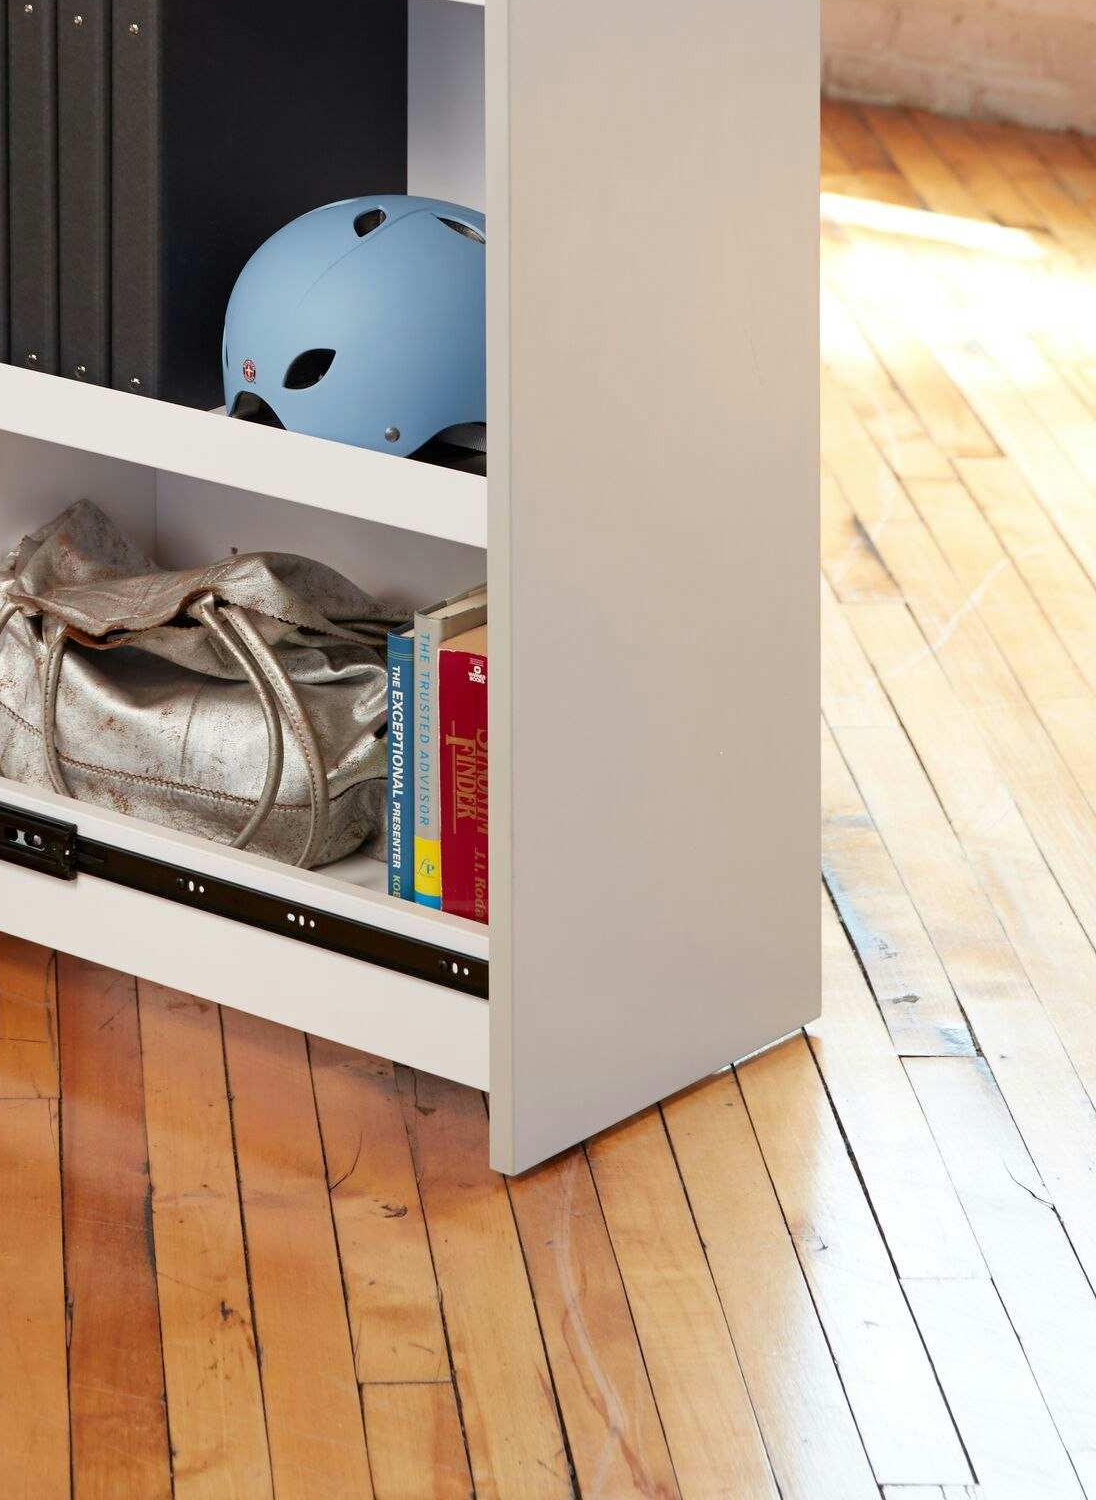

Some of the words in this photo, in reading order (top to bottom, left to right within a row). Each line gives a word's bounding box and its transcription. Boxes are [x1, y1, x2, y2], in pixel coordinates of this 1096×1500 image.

[392, 666, 401, 688] THE
[419, 632, 430, 662] THE
[419, 672, 430, 744] TRUSTED
[392, 690, 404, 798] EXCEPTIONAL
[445, 733, 477, 820] FINDER
[419, 749, 430, 826] ADVISOR
[392, 801, 401, 869] PRESENTER
[474, 876, 487, 919] Roda
